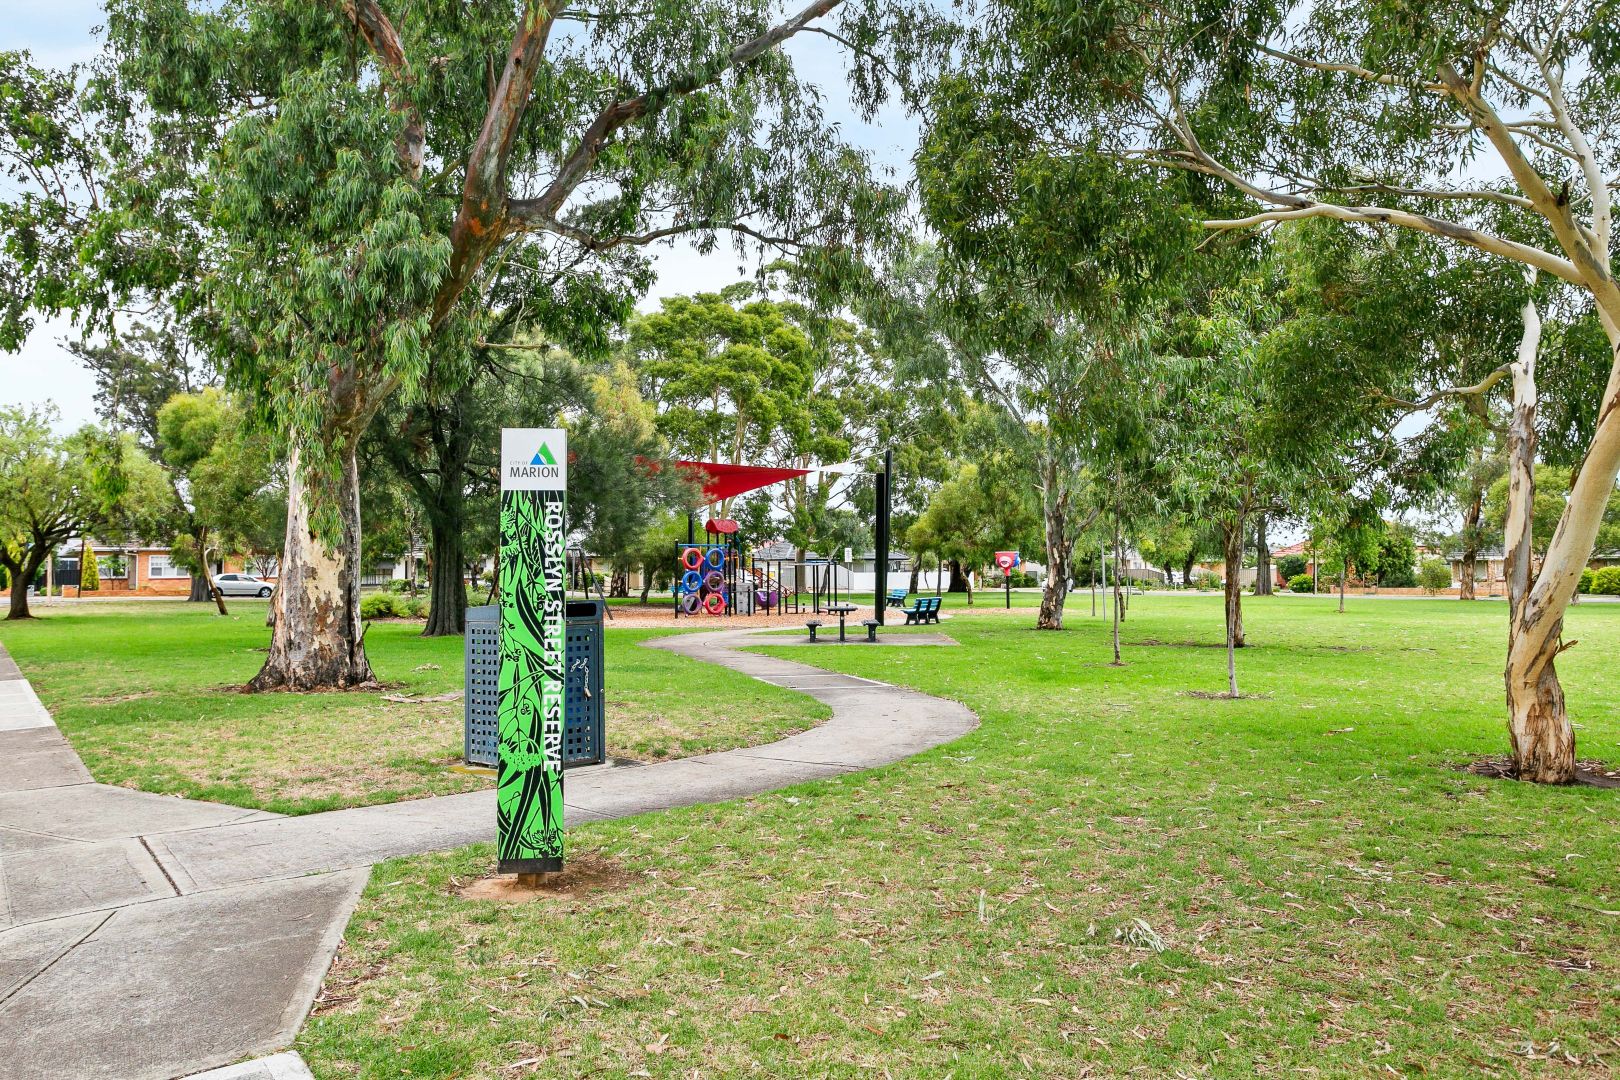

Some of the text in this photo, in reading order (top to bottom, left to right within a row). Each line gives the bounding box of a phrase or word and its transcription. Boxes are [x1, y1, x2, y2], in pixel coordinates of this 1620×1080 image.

[509, 466, 559, 478] MARION
[543, 501, 563, 772] ROSSLYN STREET RESERVE
